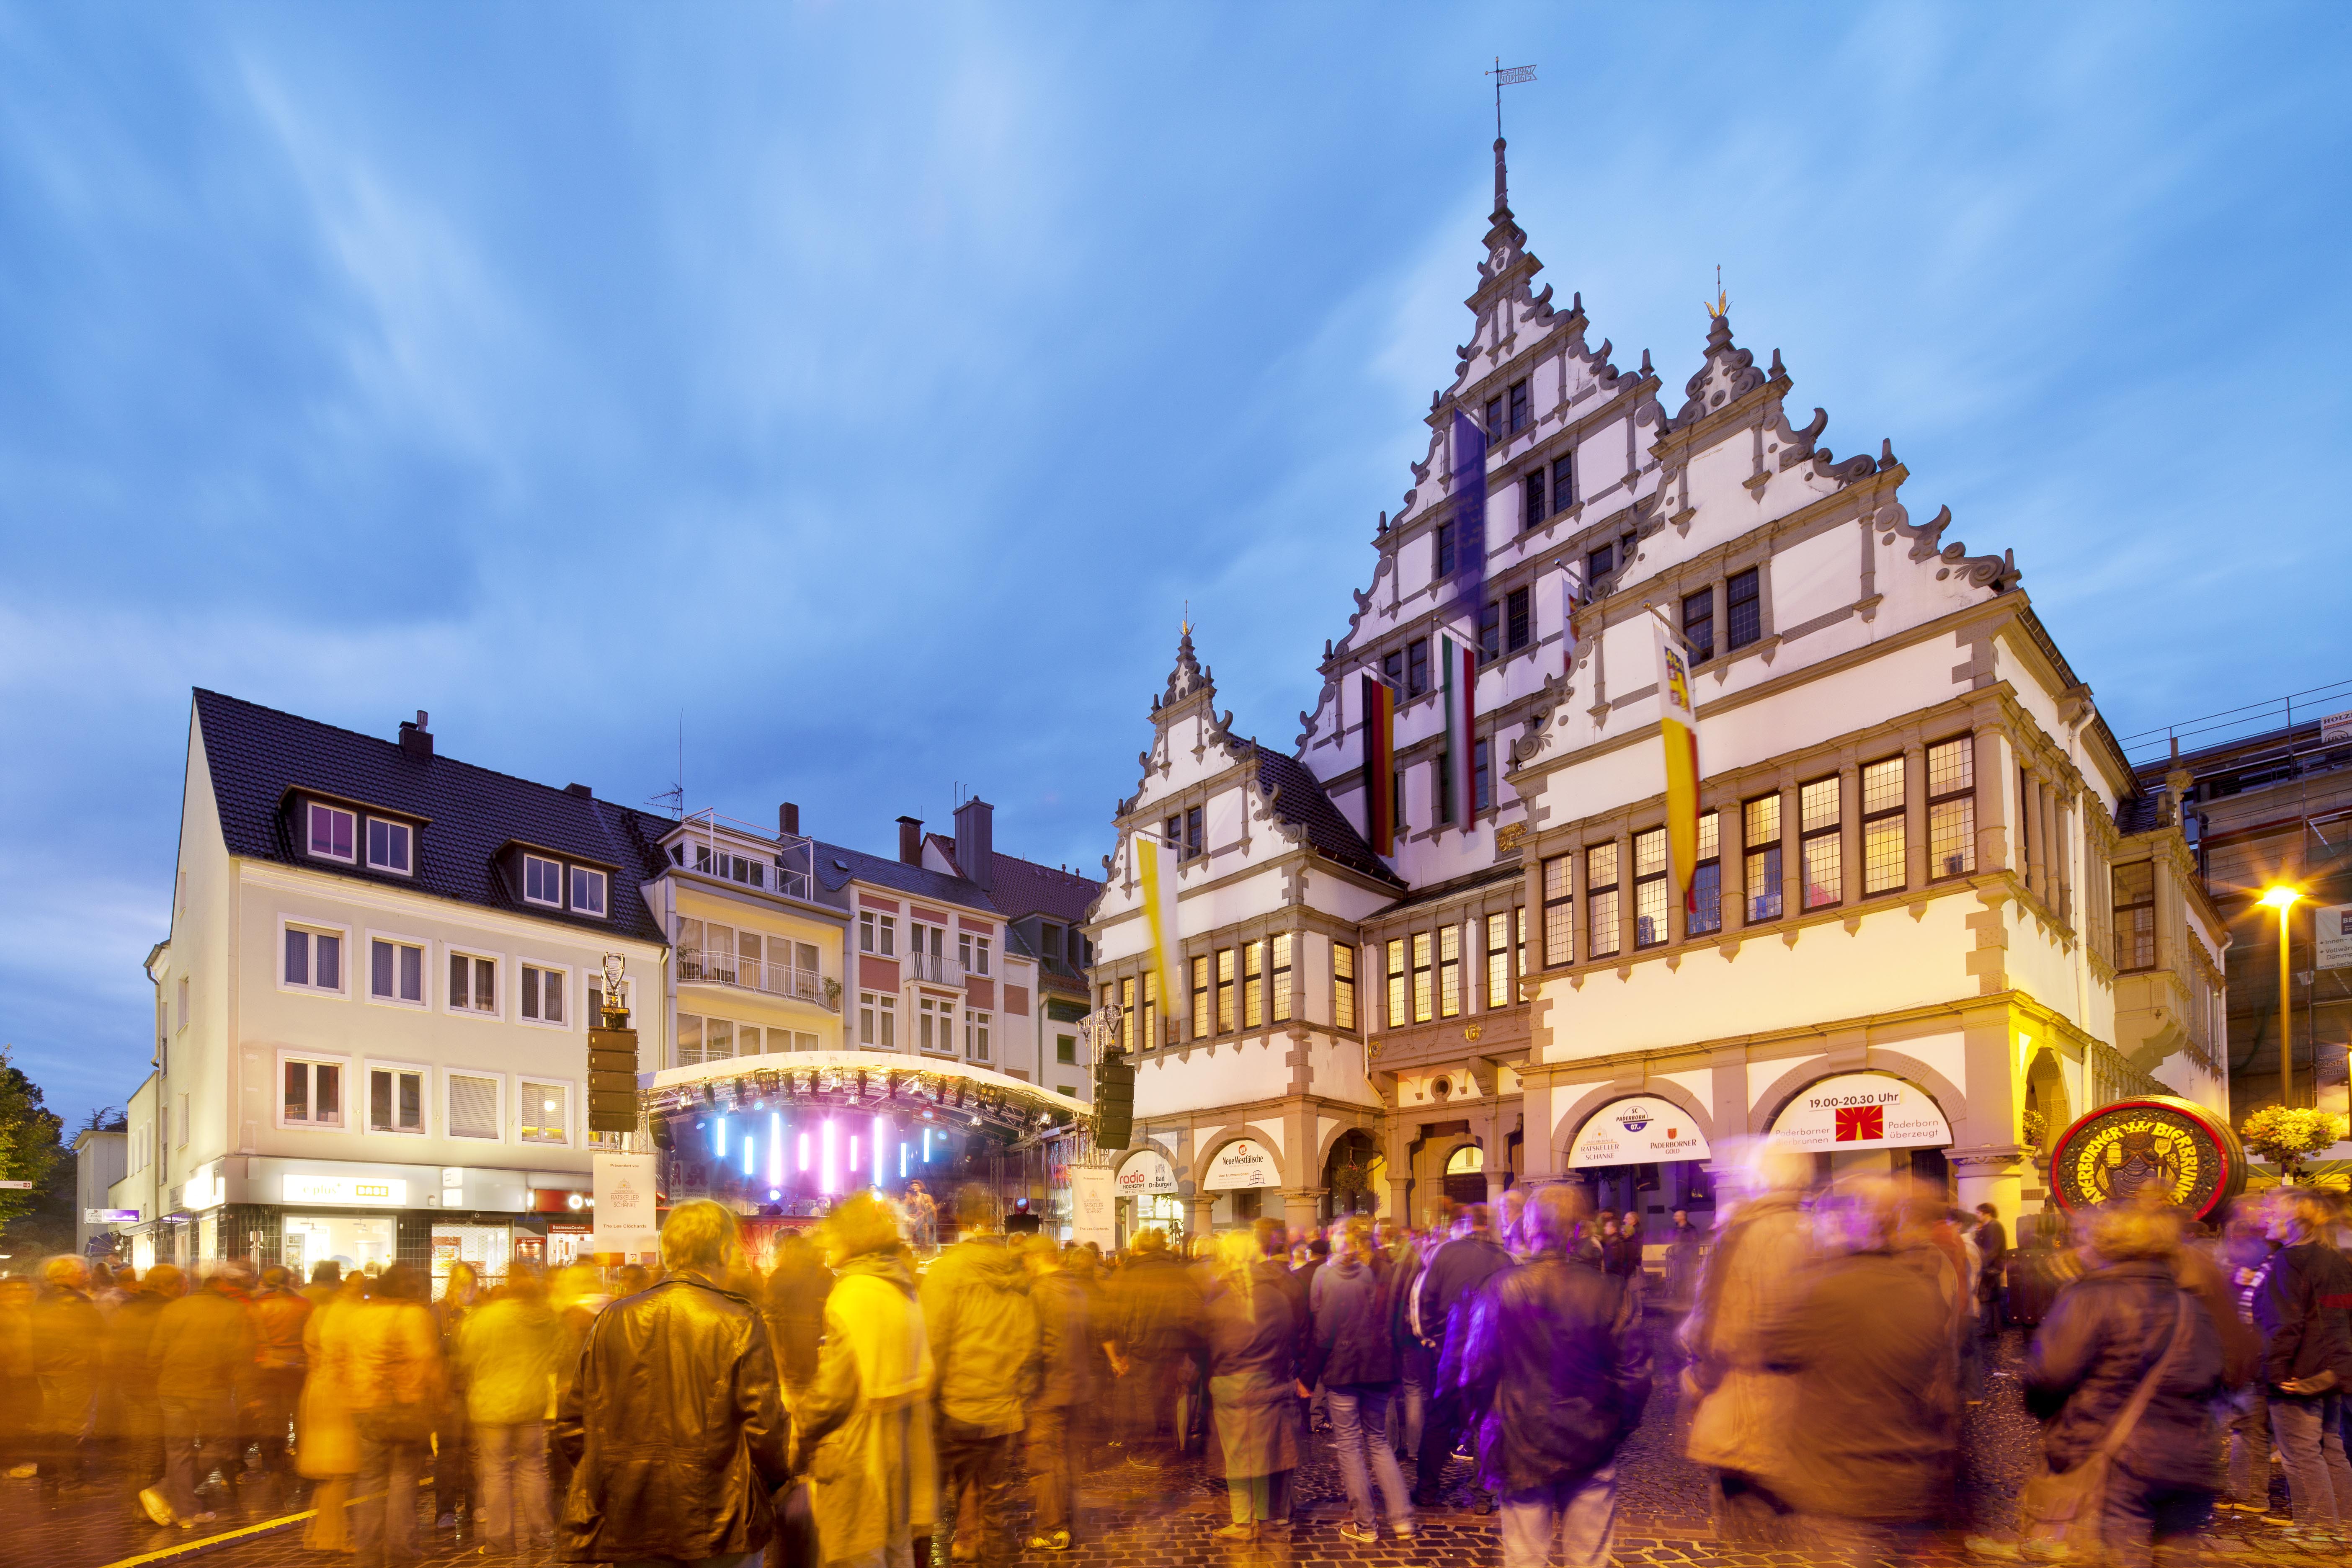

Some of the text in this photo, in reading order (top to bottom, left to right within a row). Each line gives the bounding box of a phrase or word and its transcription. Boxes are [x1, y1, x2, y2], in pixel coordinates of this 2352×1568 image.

[2323, 712, 2352, 725] HOLZ
[2318, 1060, 2343, 1068] Kraft
[1809, 1092, 1899, 1108] 19.00-20.30 Uhr
[1889, 1119, 1939, 1129] Paderborn
[1776, 1128, 1830, 1136] Paderborner
[1890, 1129, 1938, 1139] überzeugt
[1650, 1139, 1697, 1149] PADERBORNER
[1776, 1137, 1828, 1146] Bierbrunnen
[1581, 1144, 1619, 1152] RATSKELLER
[1222, 1157, 1234, 1165] Neue
[1235, 1154, 1263, 1164] Westfälische
[1119, 1170, 1145, 1184] radio
[358, 1186, 387, 1196] BASE
